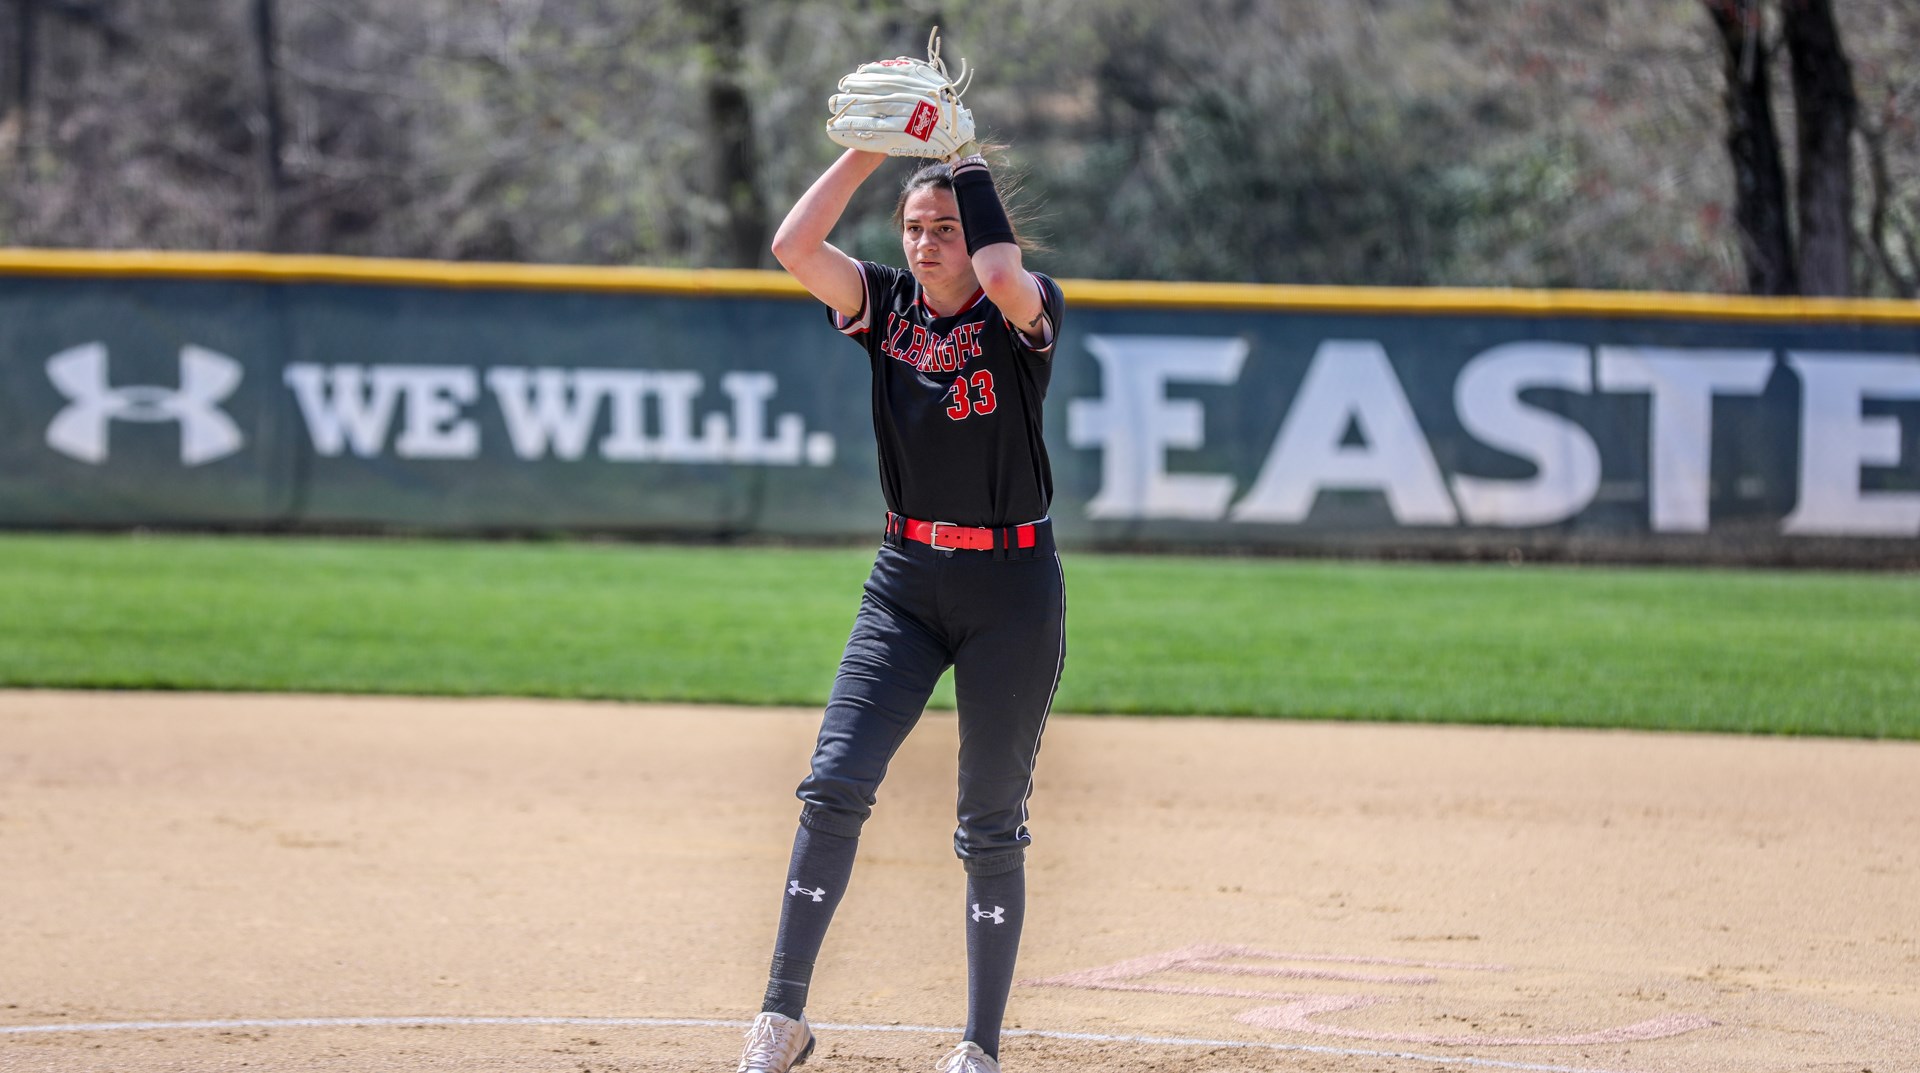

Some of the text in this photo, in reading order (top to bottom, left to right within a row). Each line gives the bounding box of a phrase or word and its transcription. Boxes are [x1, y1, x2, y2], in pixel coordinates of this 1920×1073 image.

[285, 363, 835, 466] WE WILL.
[946, 369, 997, 421] 33
[1067, 335, 1920, 536] EASTE
